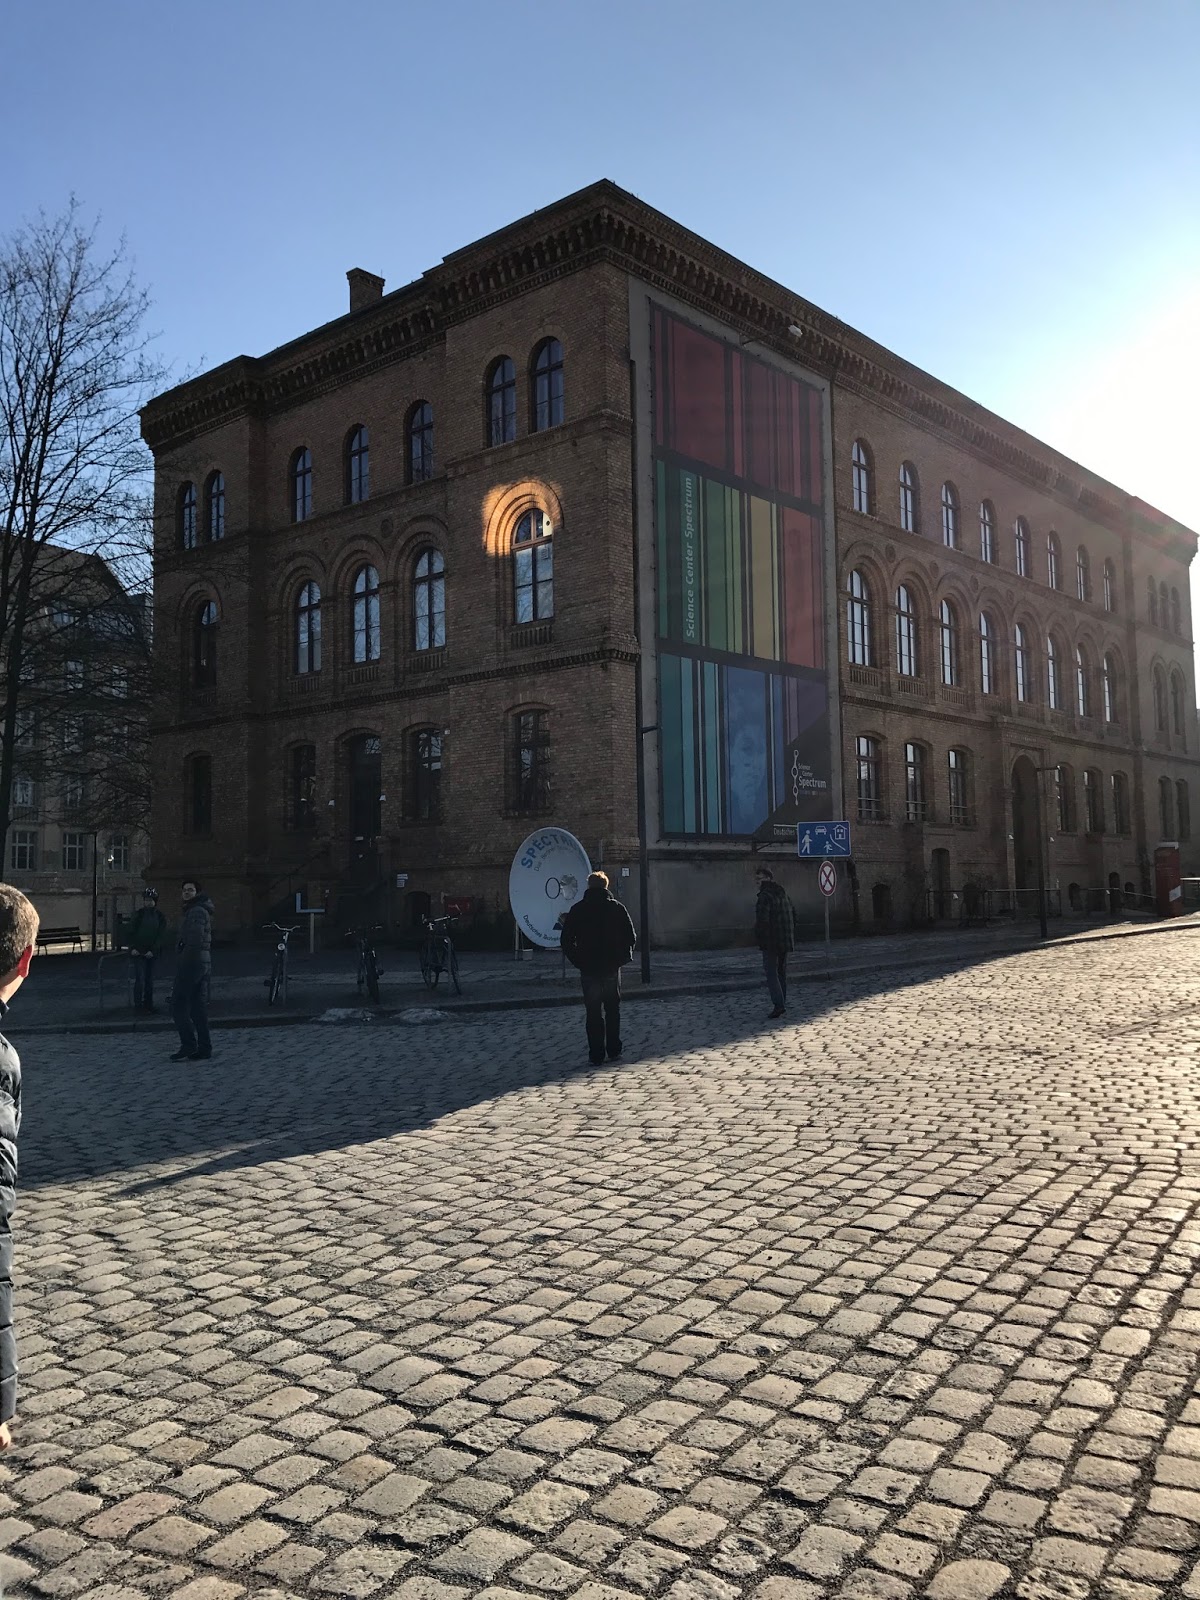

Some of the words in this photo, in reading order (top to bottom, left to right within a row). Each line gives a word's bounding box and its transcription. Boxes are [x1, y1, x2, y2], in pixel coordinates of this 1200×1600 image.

[684, 477, 695, 539] Spectrum
[685, 542, 695, 585] Center
[686, 589, 695, 638] Science
[798, 776, 826, 788] Spectrum
[523, 915, 542, 937] Deutsches
